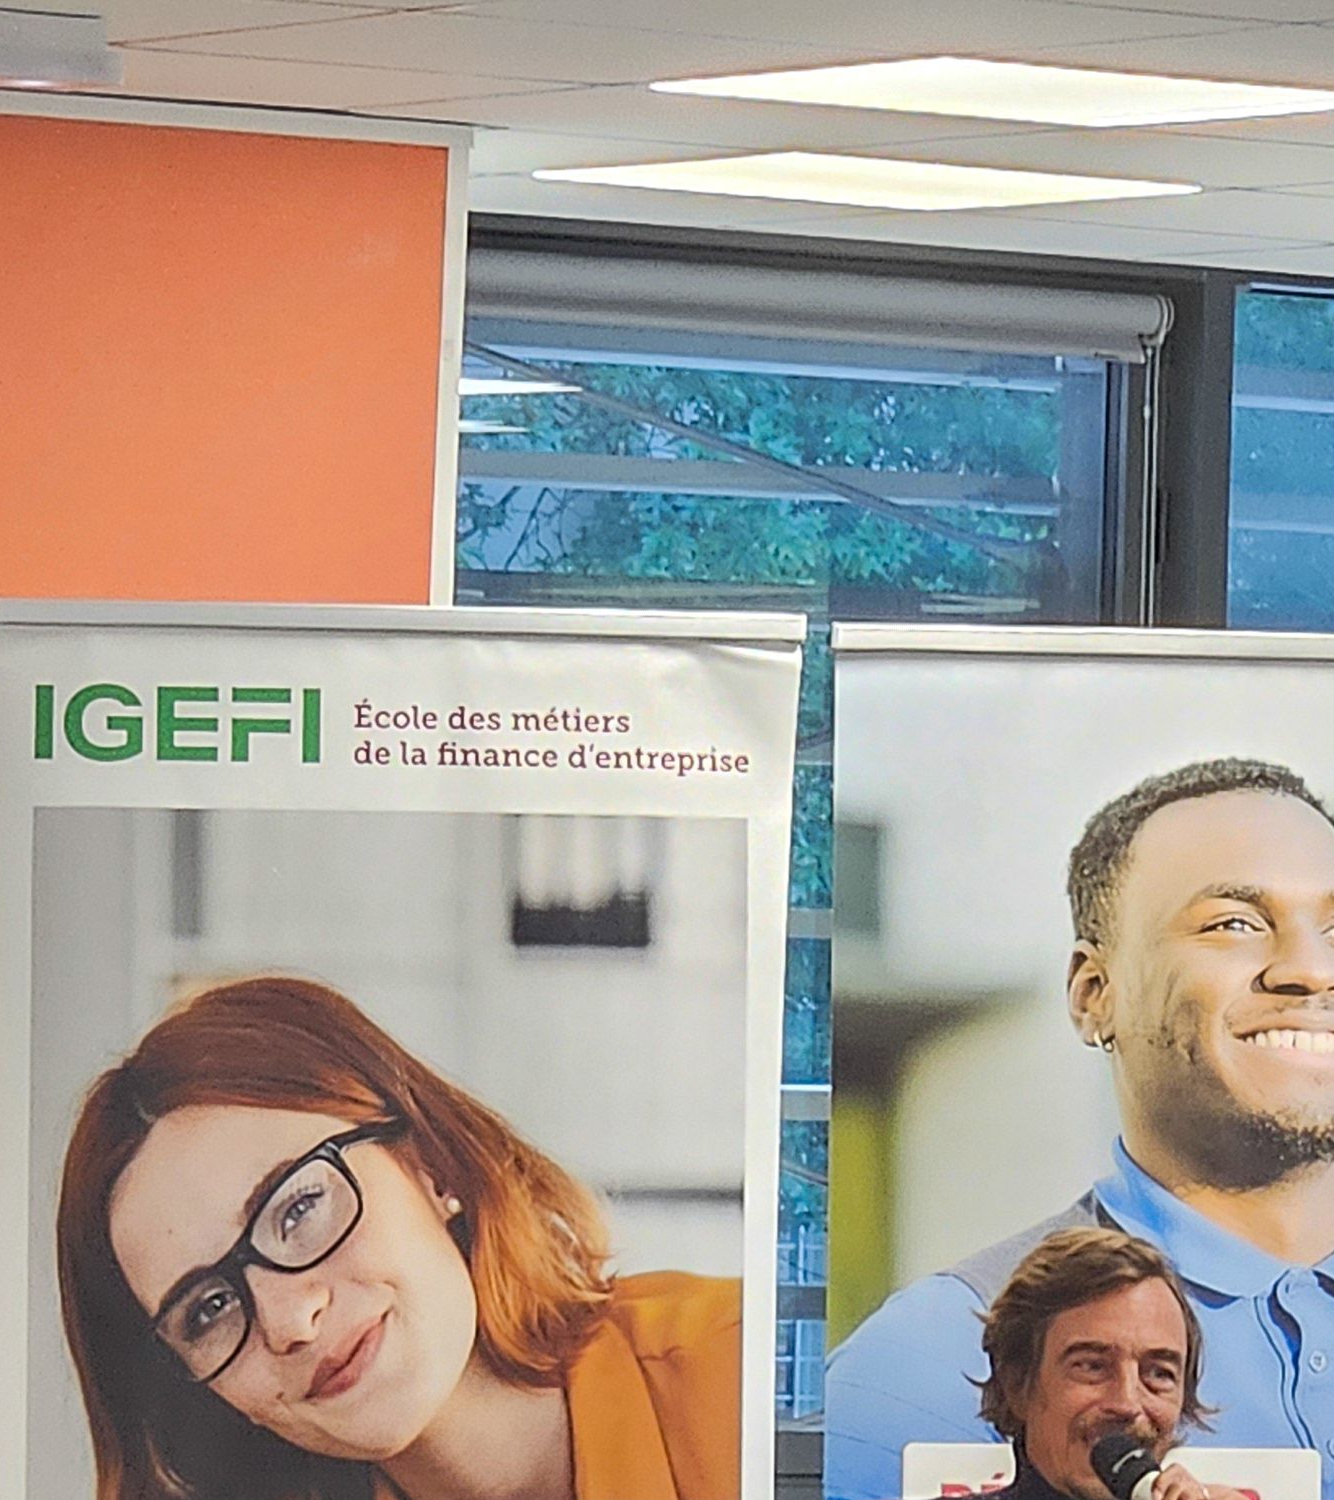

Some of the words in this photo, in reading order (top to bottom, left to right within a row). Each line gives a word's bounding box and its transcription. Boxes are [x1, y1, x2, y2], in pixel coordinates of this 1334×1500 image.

[34, 683, 322, 765] IGEFI
[353, 699, 438, 732] École
[447, 704, 501, 733] des
[511, 705, 631, 736] métiers
[353, 741, 392, 768] de
[399, 741, 428, 768] la
[437, 742, 559, 770] finance
[567, 743, 750, 778] d'entreprise
